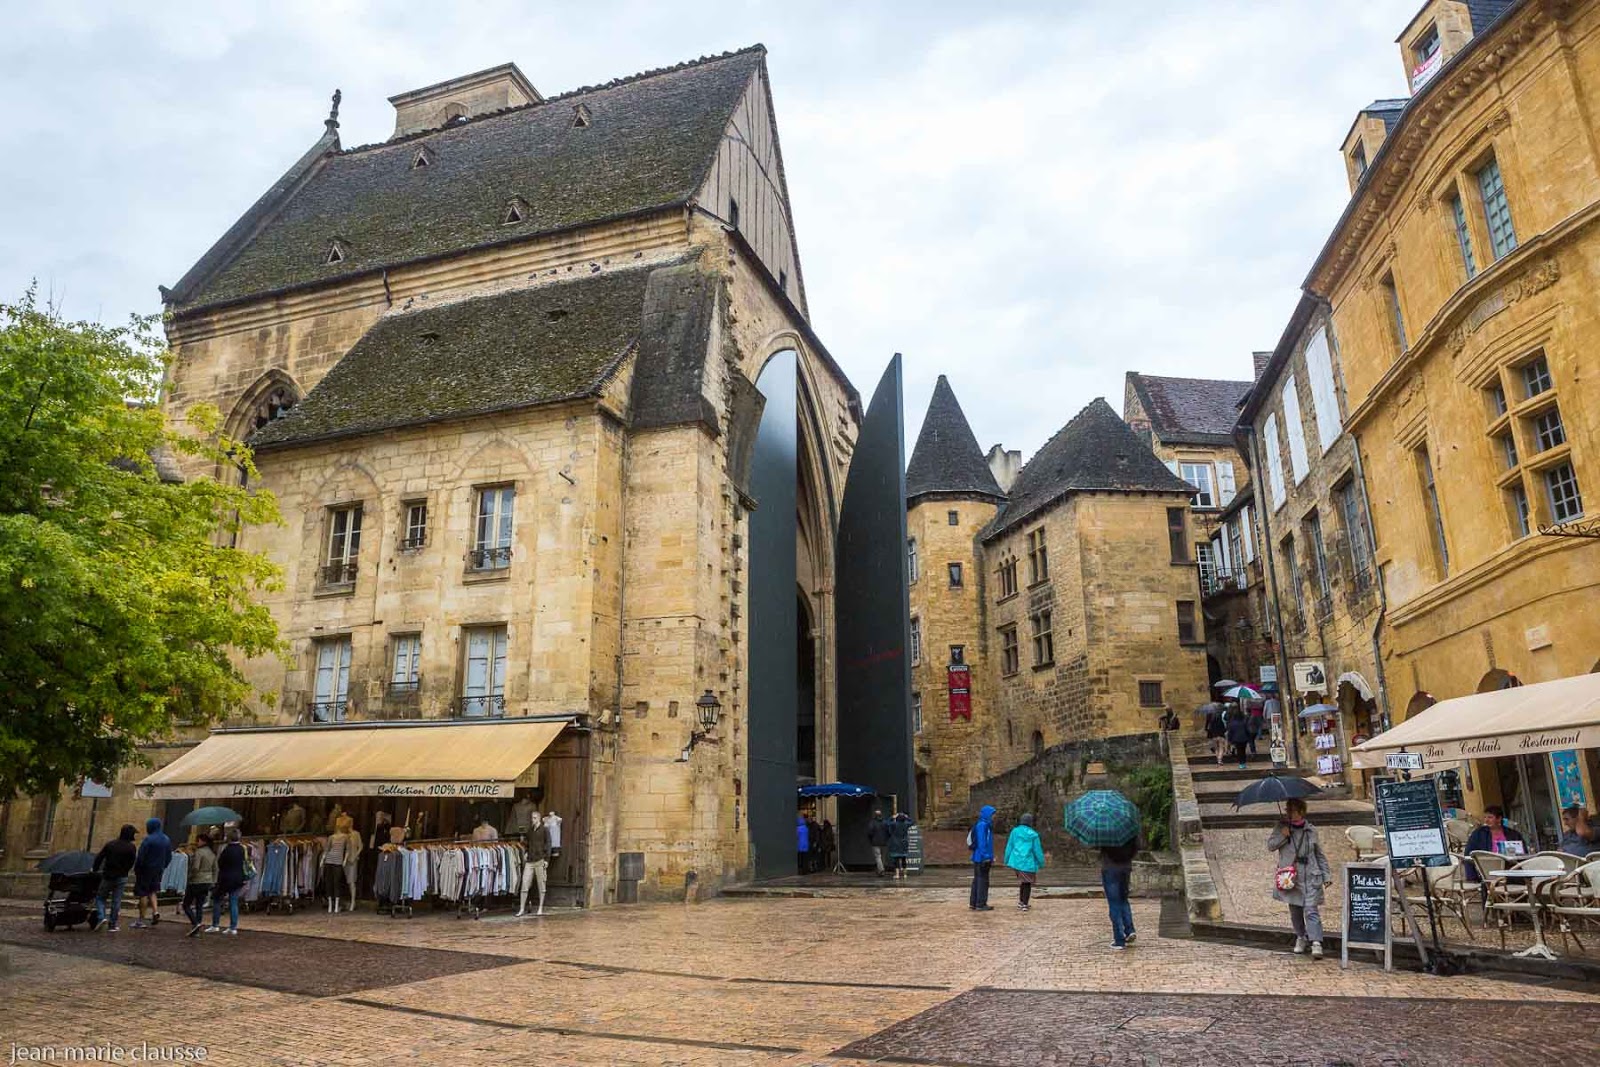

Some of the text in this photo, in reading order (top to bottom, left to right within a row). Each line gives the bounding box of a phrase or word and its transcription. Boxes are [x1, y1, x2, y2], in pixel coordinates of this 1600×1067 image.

[1425, 730, 1581, 758] Bar Cocktails Restaurant
[233, 785, 243, 796] Le
[377, 784, 500, 796] Collection 100% NATURE
